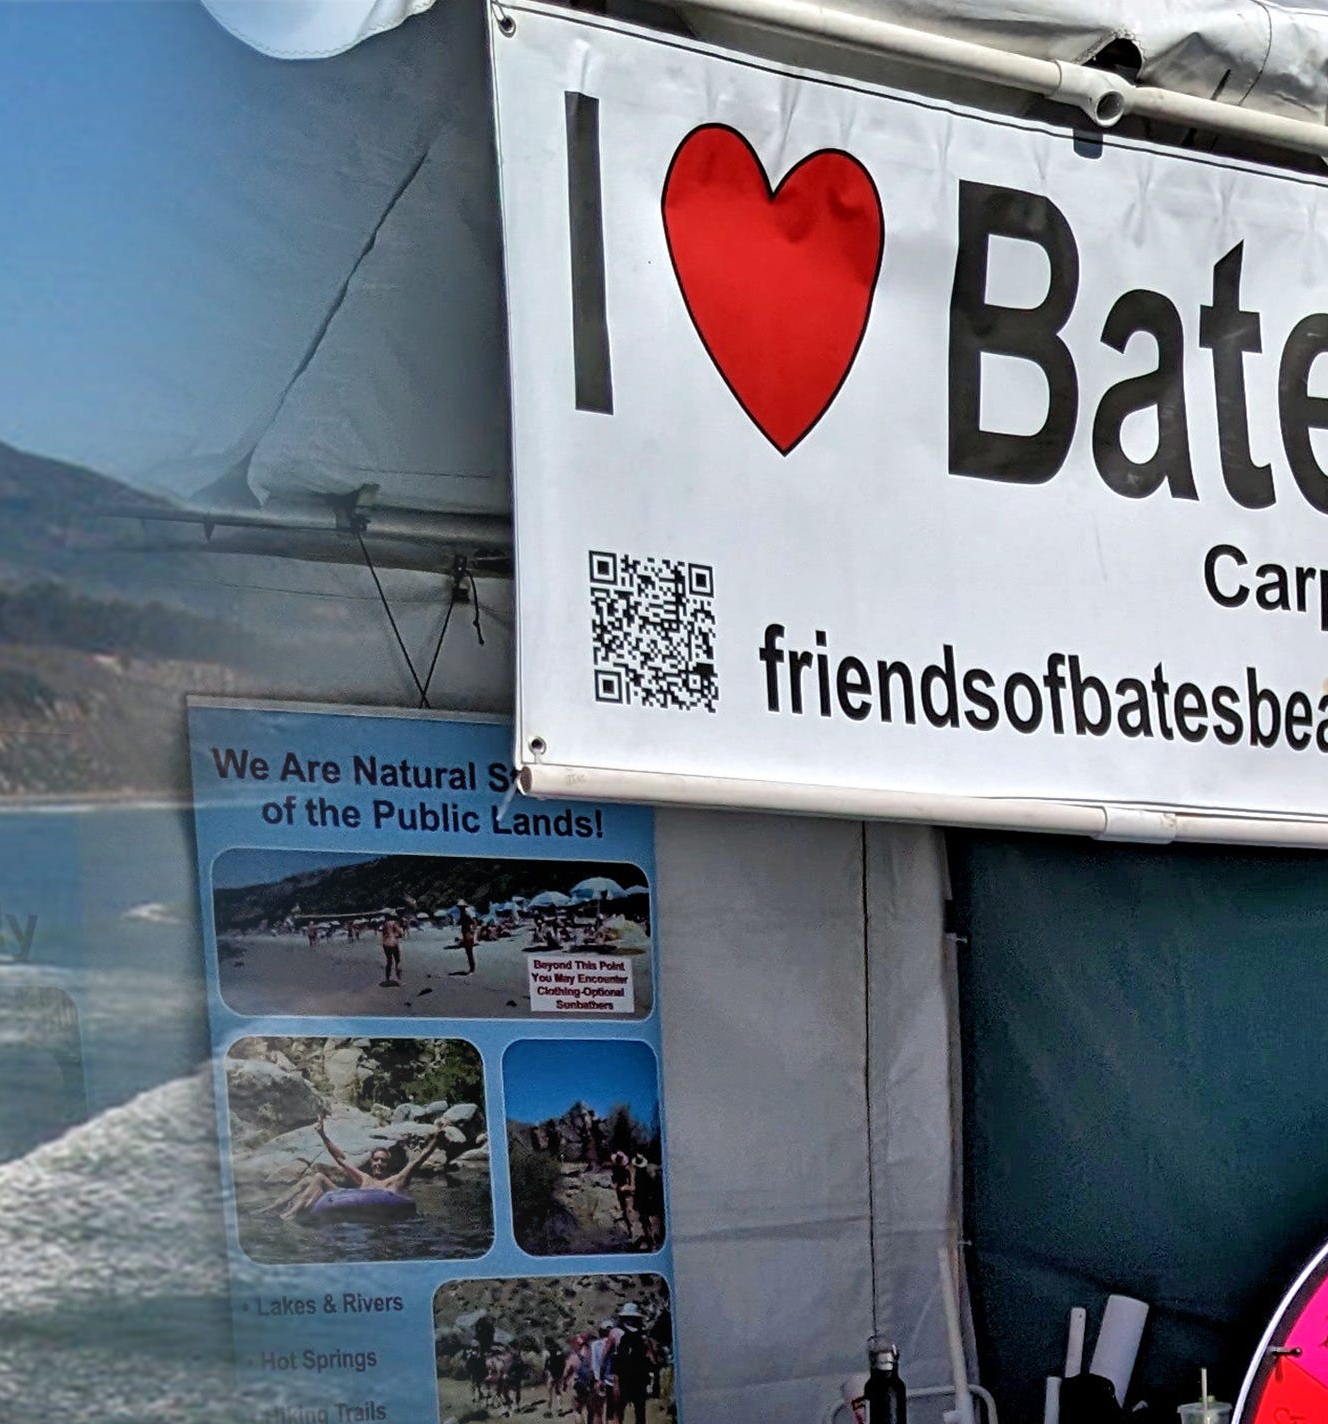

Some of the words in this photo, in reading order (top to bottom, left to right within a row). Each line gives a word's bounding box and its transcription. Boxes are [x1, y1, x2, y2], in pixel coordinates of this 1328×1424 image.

[565, 90, 614, 413] I
[212, 748, 269, 780] We
[280, 753, 341, 783] Are
[353, 757, 476, 792] Natural
[262, 796, 295, 826] of
[306, 797, 360, 827] the
[374, 800, 480, 833] Public
[492, 807, 604, 838] Lands!
[533, 960, 572, 971] Beyond
[575, 961, 597, 970] This
[600, 961, 626, 971] Point
[531, 973, 552, 982] You
[555, 974, 575, 985] May
[578, 974, 628, 984] Encounter
[537, 986, 625, 998] Clothing-Optional
[556, 1000, 614, 1010] Sunbathers
[257, 1295, 317, 1317] Lakes
[323, 1294, 337, 1314] &
[343, 1293, 404, 1313] Rivers
[261, 1351, 297, 1370] Hot
[303, 1349, 377, 1374] Springs
[335, 1401, 387, 1423] Trails
